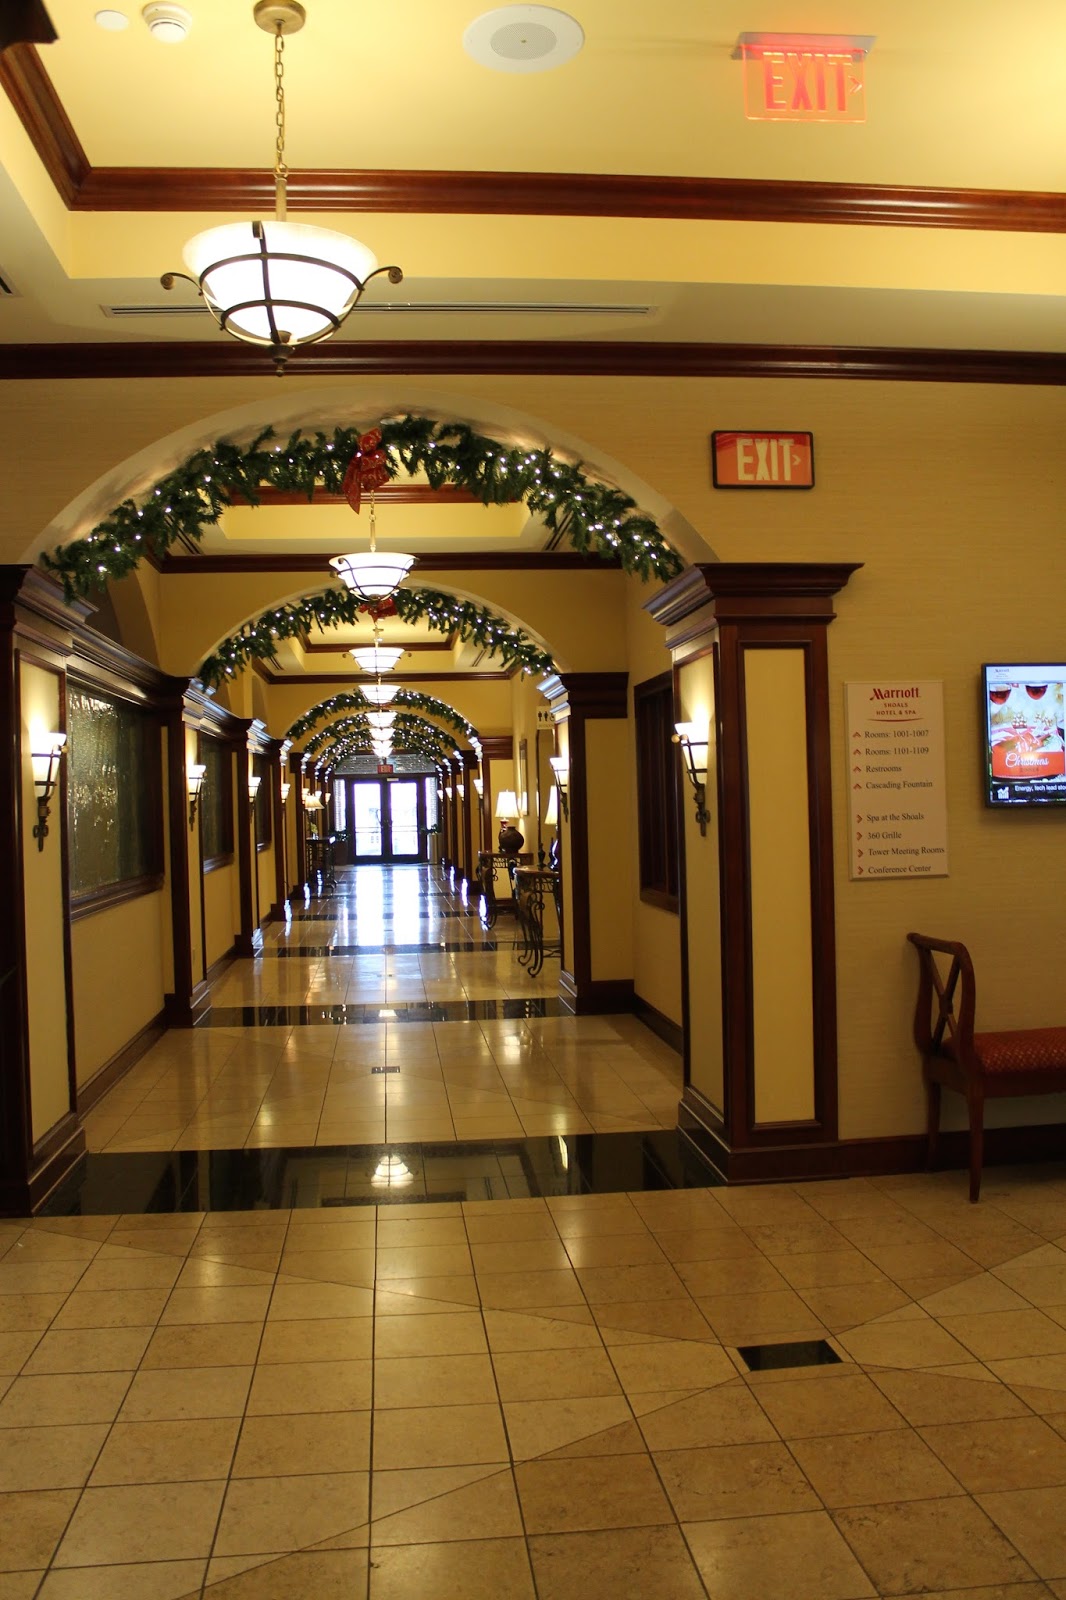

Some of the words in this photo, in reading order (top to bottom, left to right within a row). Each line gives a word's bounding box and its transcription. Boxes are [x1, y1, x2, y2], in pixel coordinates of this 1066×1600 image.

[763, 52, 852, 112] EXIT
[736, 438, 794, 481] EXIT
[869, 687, 919, 701] Marriott
[864, 731, 891, 739] Rooms:
[893, 729, 929, 738] 1001-1007
[865, 748, 891, 756] Rooms:
[894, 747, 929, 755] 1101-1109
[866, 781, 901, 790] Cascading
[903, 780, 933, 788] Fountain
[867, 814, 880, 823] Spa
[901, 812, 925, 820] Shoals
[882, 831, 902, 839] Grille
[868, 848, 889, 856] Tower
[891, 847, 919, 856] Meeting
[868, 866, 907, 874] Conference
